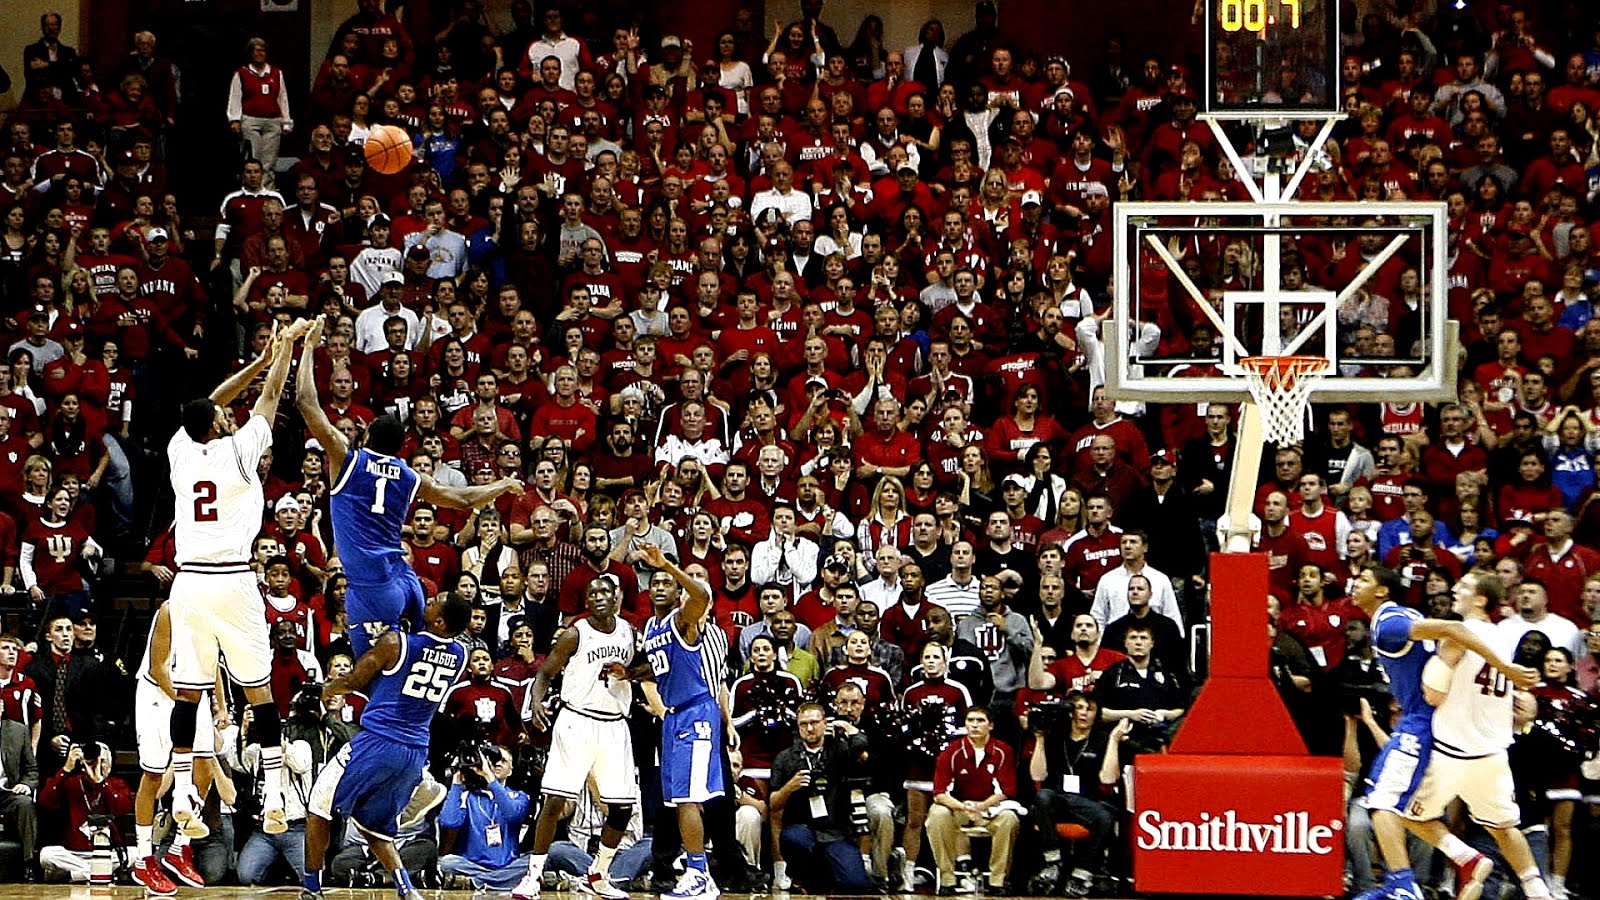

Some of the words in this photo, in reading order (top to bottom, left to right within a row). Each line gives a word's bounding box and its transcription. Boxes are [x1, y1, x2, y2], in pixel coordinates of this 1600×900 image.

[140, 279, 176, 297] INDIANA
[365, 459, 401, 480] MILLER
[193, 481, 218, 521] 2
[370, 477, 388, 514] 1
[422, 647, 462, 669] TEAGUE
[402, 663, 457, 703] 25
[1475, 661, 1508, 698] 40
[1136, 810, 1332, 855] Smithville
